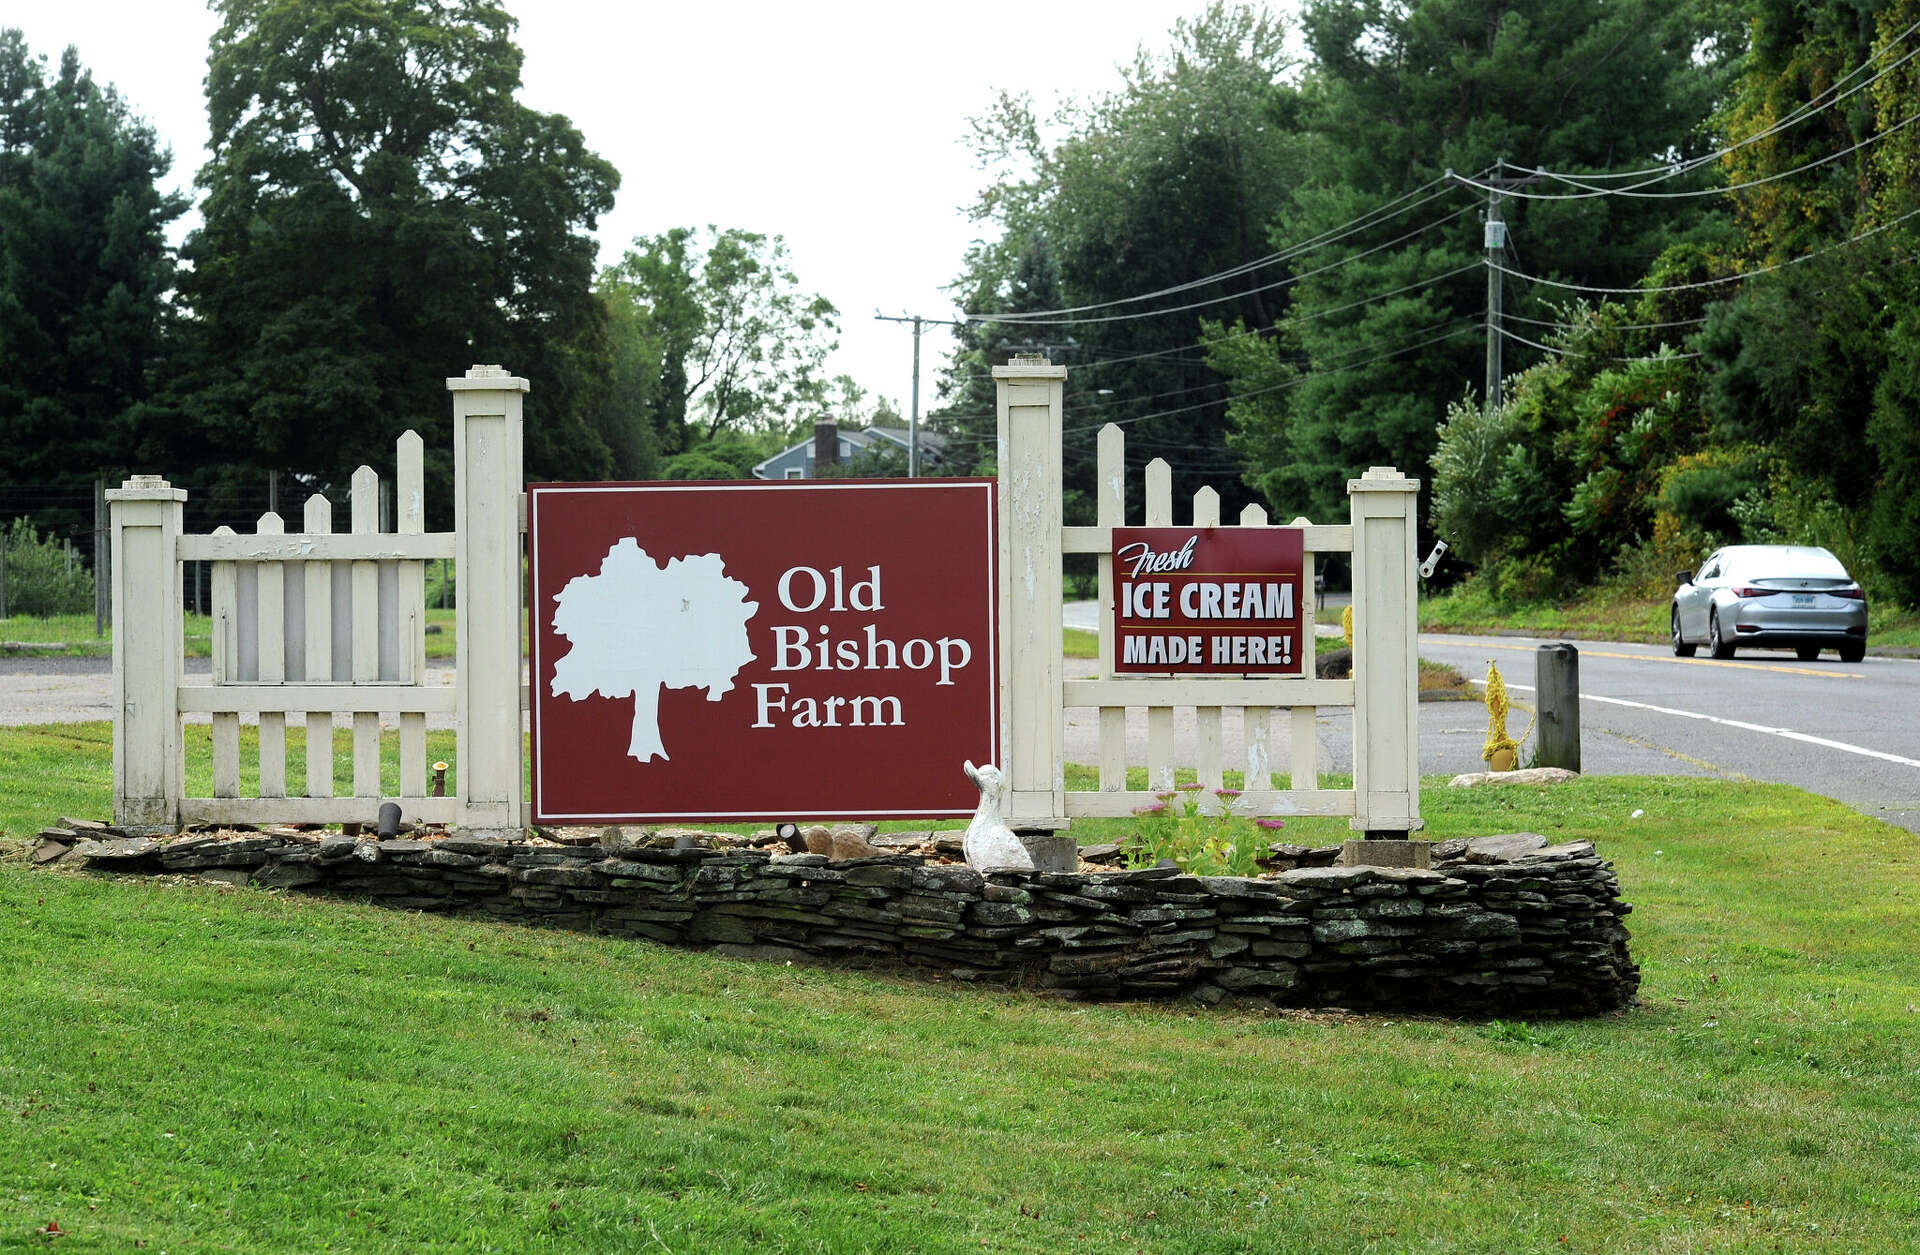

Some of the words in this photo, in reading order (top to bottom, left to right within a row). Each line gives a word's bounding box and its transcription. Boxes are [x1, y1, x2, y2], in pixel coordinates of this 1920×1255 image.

[1117, 535, 1198, 578] Fresh
[777, 565, 885, 612] Old
[1122, 582, 1170, 618] ICE
[1180, 583, 1294, 619] CREAM
[770, 624, 972, 685] Bishop
[1123, 635, 1202, 664] MADE
[1211, 635, 1292, 664] HERE!
[751, 683, 905, 728] Farm
